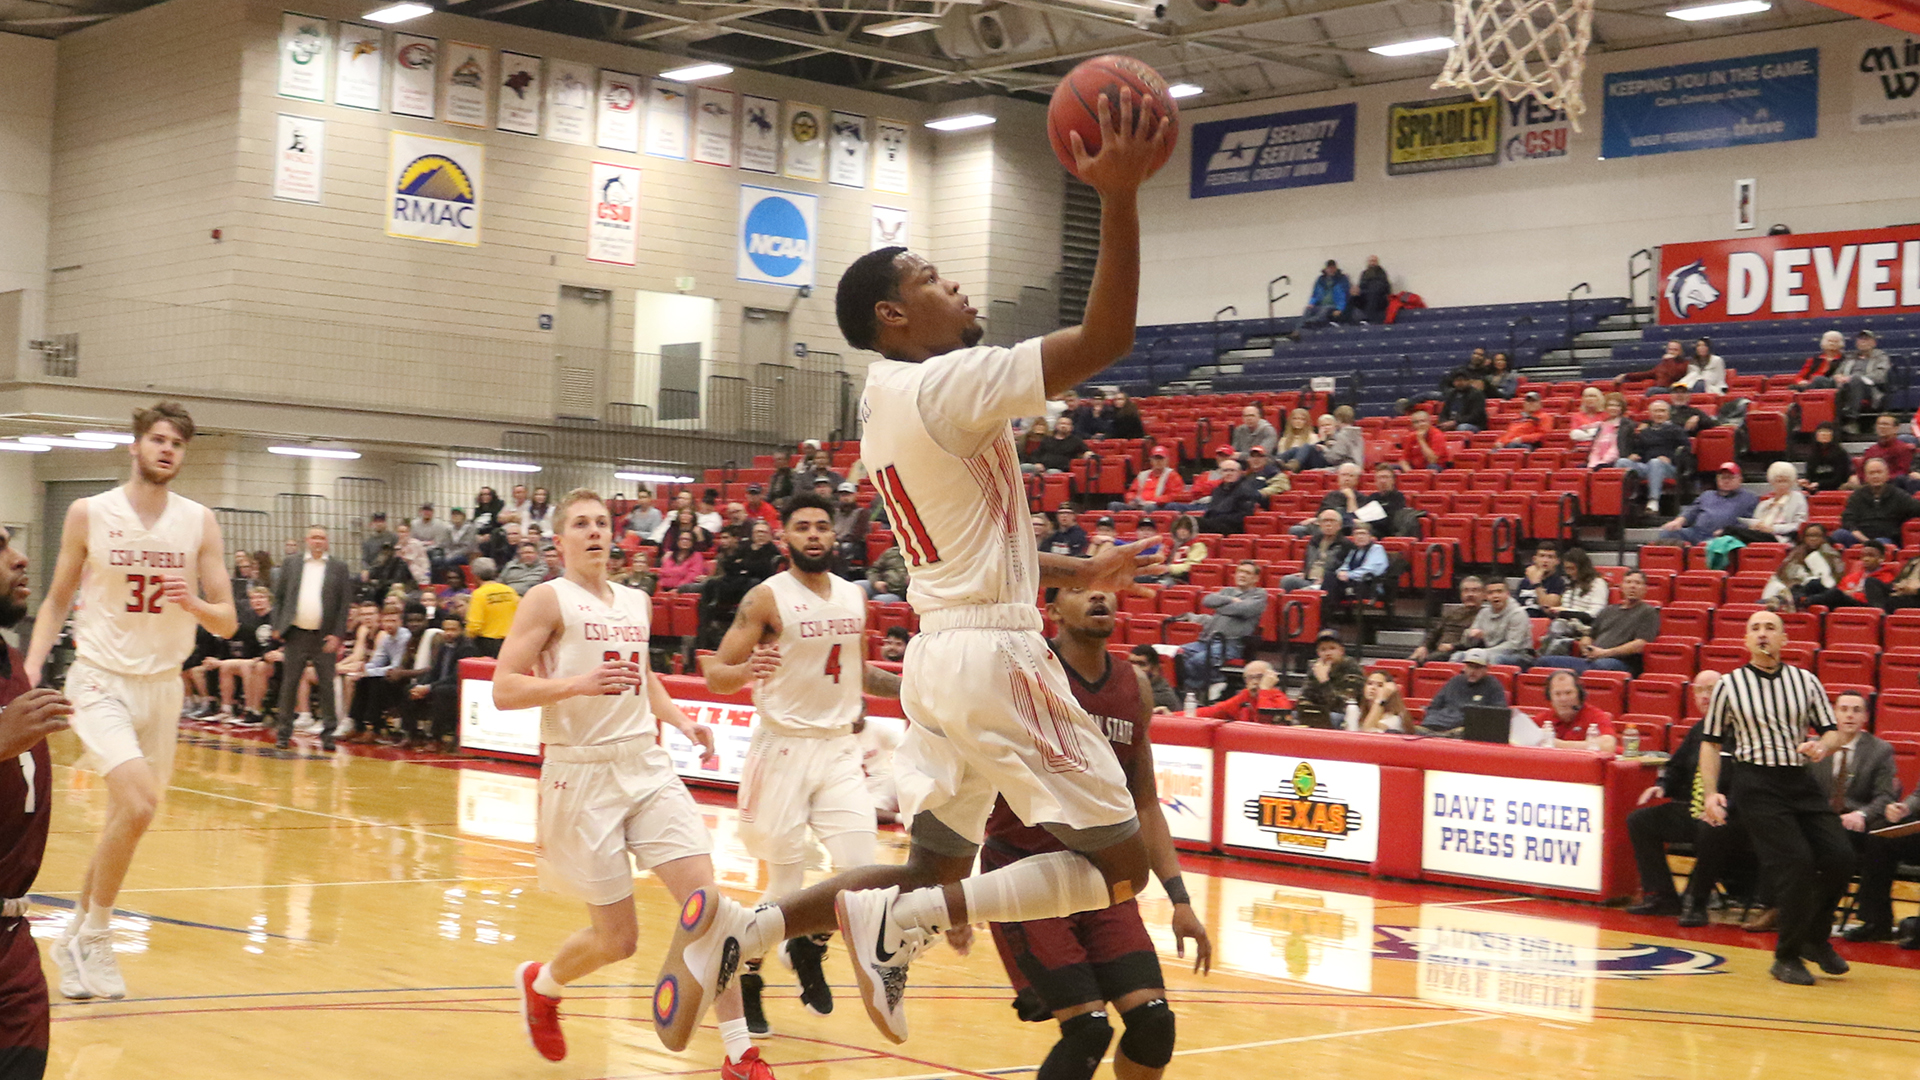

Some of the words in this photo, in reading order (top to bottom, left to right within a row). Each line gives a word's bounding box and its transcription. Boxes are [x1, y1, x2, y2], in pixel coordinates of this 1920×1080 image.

[1609, 76, 1673, 97] KEEPING
[1675, 73, 1708, 89] YOU
[1709, 71, 1727, 85] IN
[1729, 65, 1759, 82] THE
[1761, 60, 1815, 80] GAME.
[1268, 119, 1340, 145] SECURITY
[1397, 106, 1492, 150] SPRADLEY
[1525, 127, 1567, 154] CSU
[1259, 140, 1322, 166] SERVICE
[1205, 171, 1250, 187] FEDERAL
[1252, 165, 1293, 181] CREDIT
[394, 197, 474, 229] RMAC
[597, 202, 632, 222] CSU
[749, 232, 816, 262] NCAA
[1726, 239, 1920, 317] DEVEL
[876, 464, 942, 567] 11
[110, 549, 186, 569] CSU-PUEBLO
[126, 573, 164, 614] 32
[824, 643, 842, 684] 4
[1105, 716, 1134, 746] STATE
[1259, 796, 1347, 833] TEXAS
[1434, 793, 1495, 822] DAVE
[1506, 800, 1591, 833] SOCIER
[1440, 826, 1514, 859] PRESS
[1525, 835, 1581, 866] ROW
